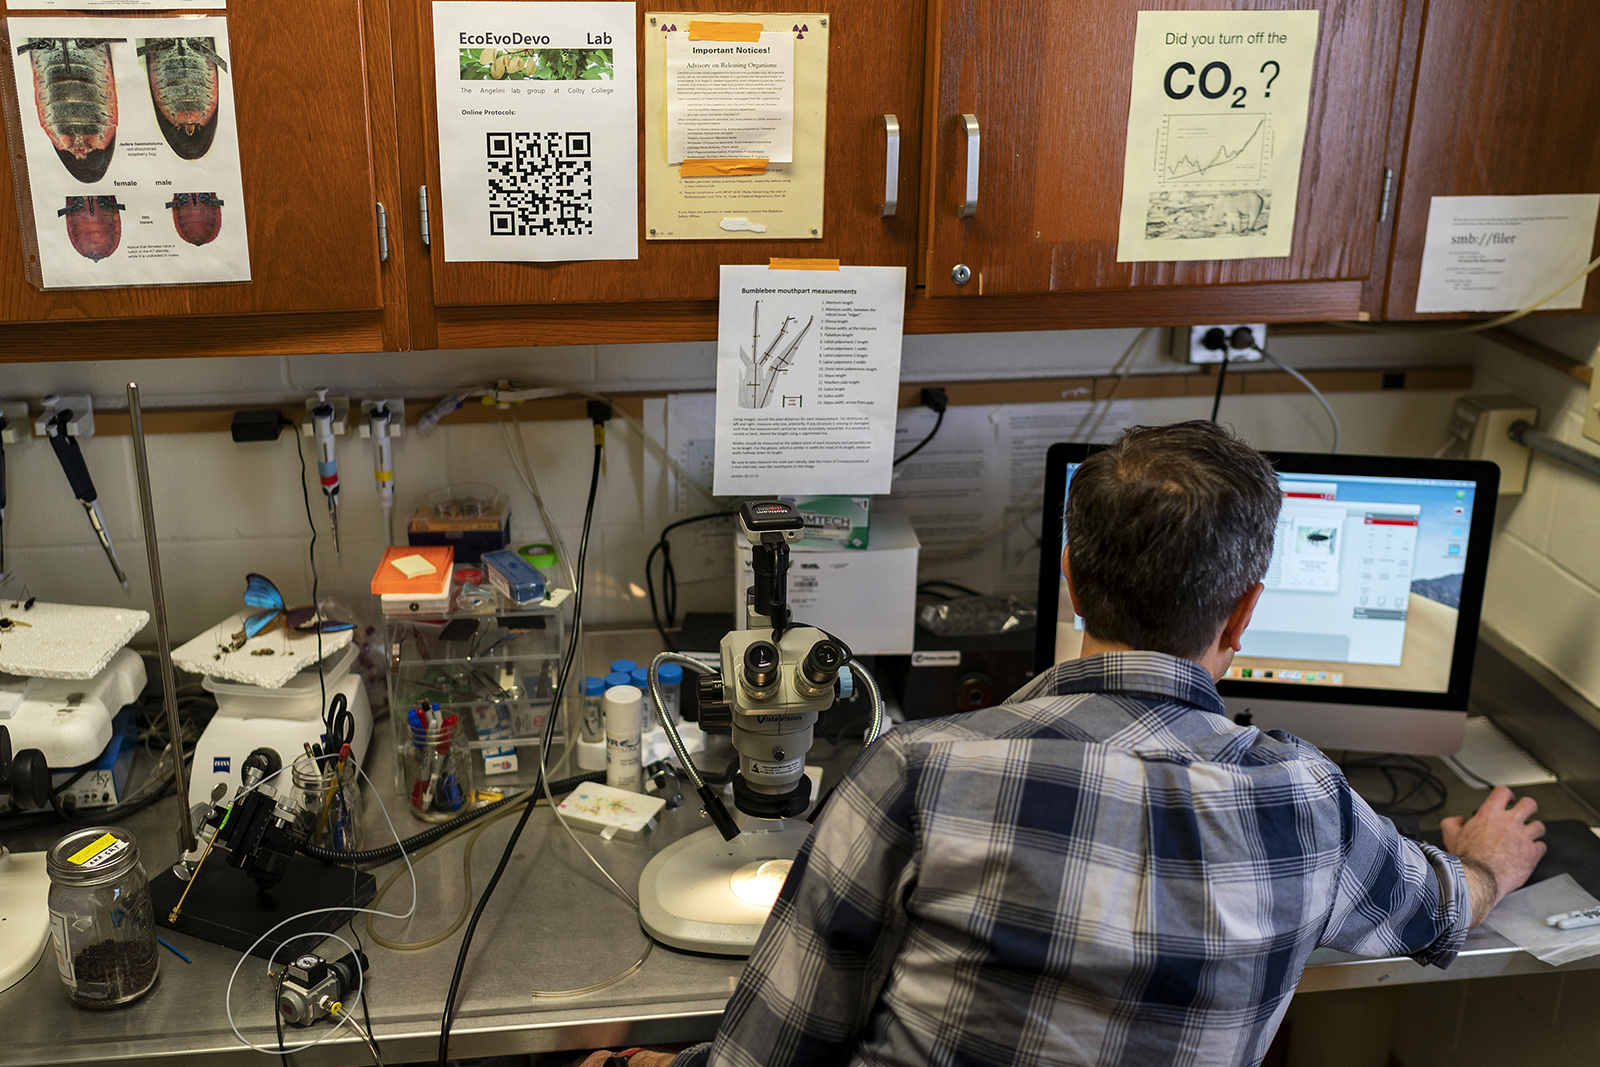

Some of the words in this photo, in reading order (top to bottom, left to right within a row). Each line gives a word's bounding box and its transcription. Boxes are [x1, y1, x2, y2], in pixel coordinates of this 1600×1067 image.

[460, 32, 550, 45] EcoEvoDevo
[587, 32, 612, 45] Lab
[1166, 32, 1188, 45] Did
[1192, 35, 1215, 48] you
[1219, 33, 1243, 44] turn
[1247, 32, 1265, 44] off
[1268, 32, 1287, 44] the
[1260, 61, 1280, 98] ?
[1451, 232, 1518, 246] smb://filer
